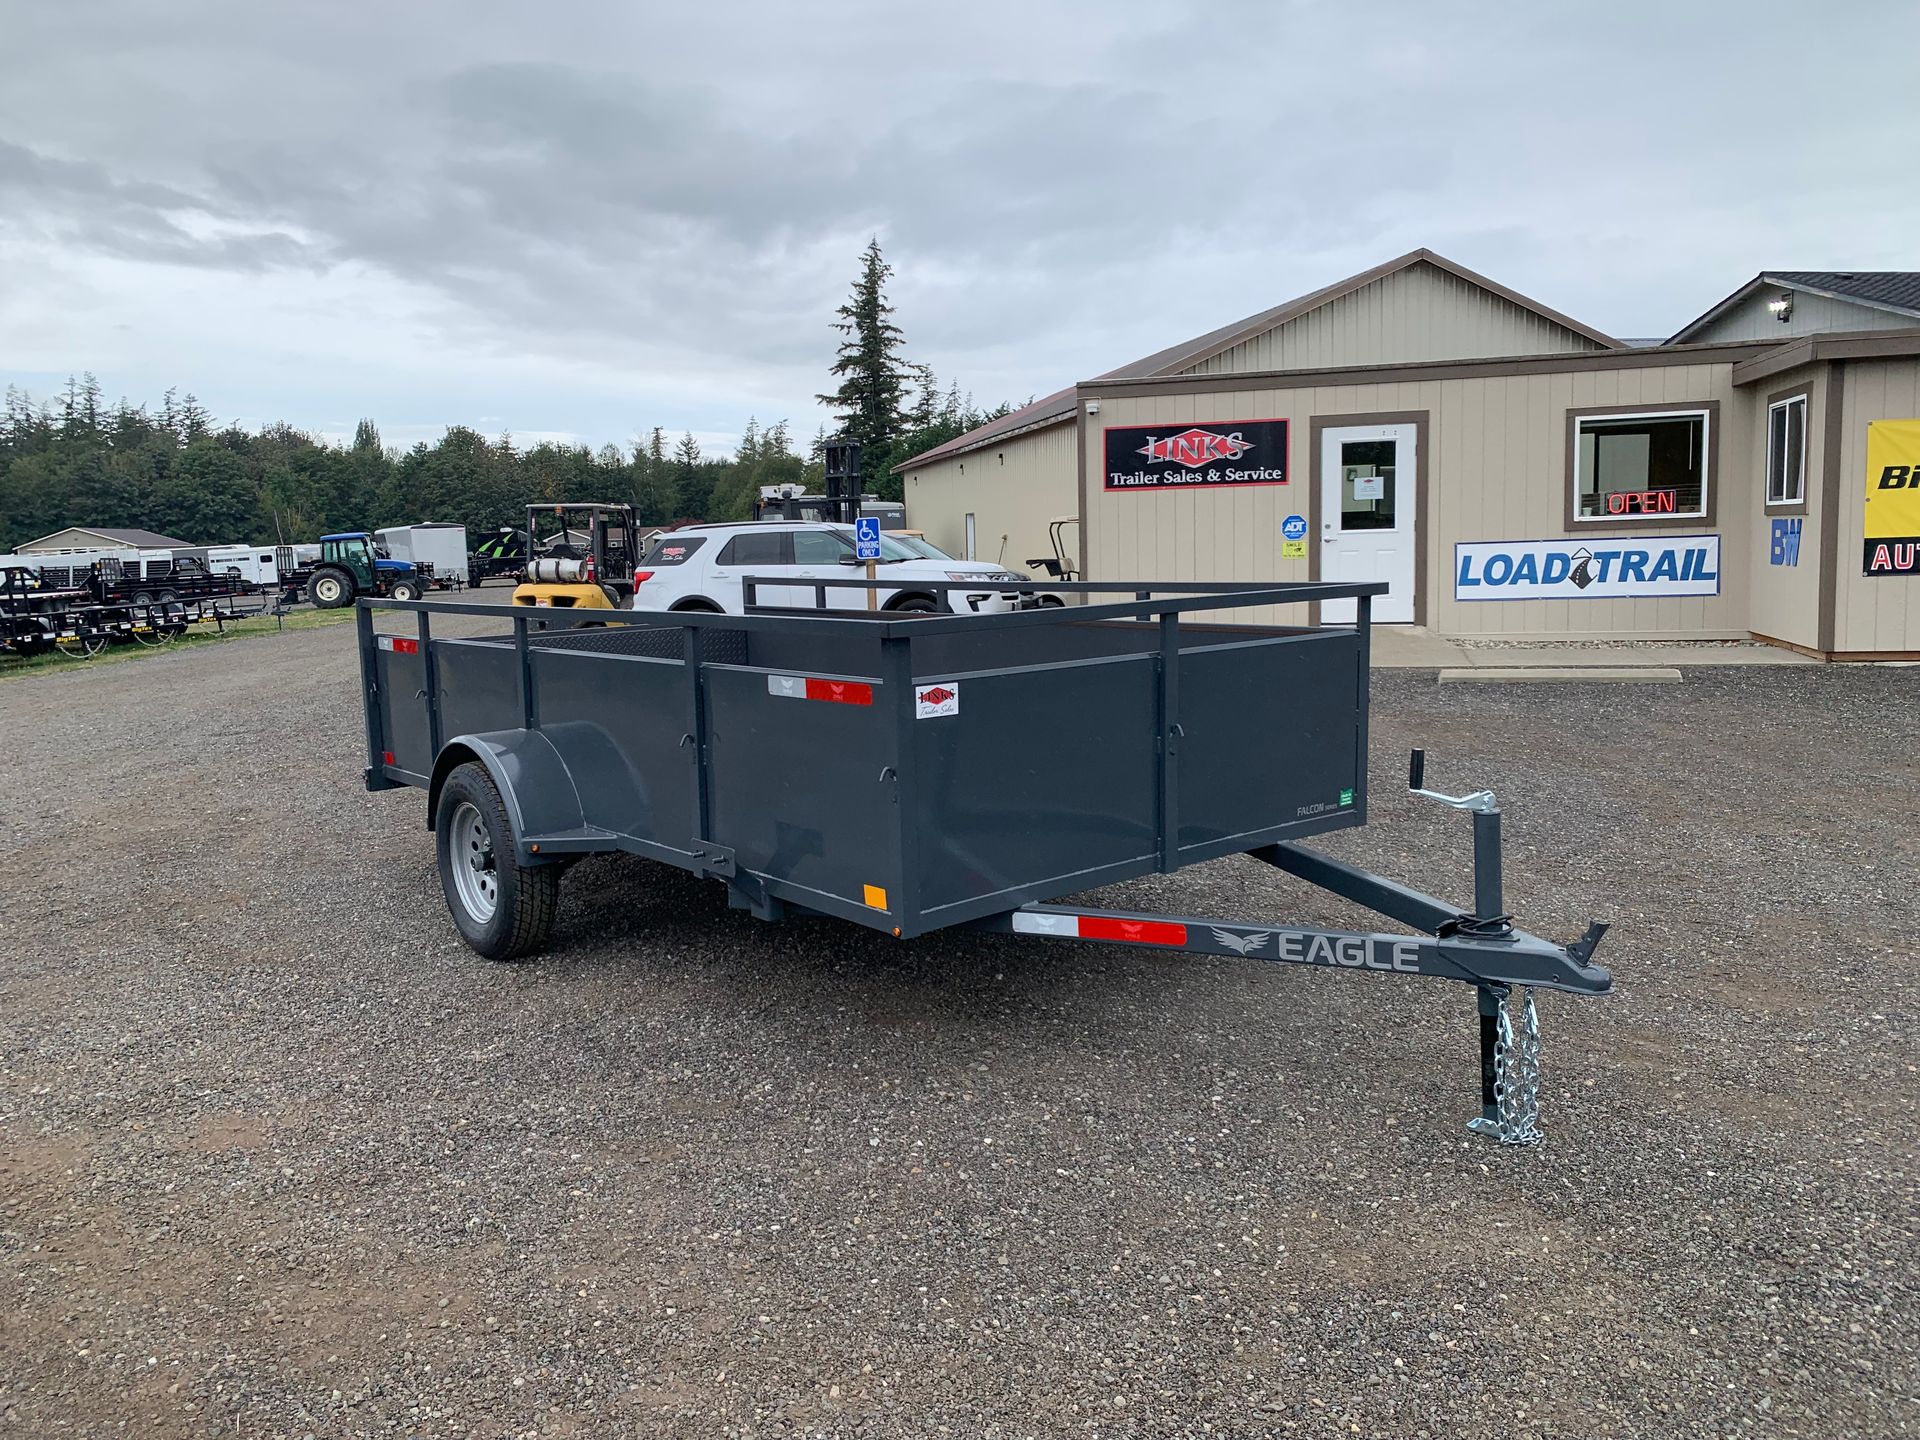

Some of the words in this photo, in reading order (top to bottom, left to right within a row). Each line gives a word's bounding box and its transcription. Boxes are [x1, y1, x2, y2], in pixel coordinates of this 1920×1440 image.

[1146, 431, 1245, 465] LINKS
[1110, 471, 1160, 486] Trailer
[1163, 469, 1203, 484] Sales
[1206, 468, 1221, 482] &
[1225, 466, 1282, 481] Service
[1608, 492, 1673, 513] OPEN
[1284, 521, 1305, 532] ADT
[858, 540, 879, 549] PARKING
[861, 548, 876, 557] ONLY
[1871, 543, 1920, 570] AU
[1458, 552, 1571, 586] LOAD
[1593, 548, 1717, 583] TRAIL
[920, 688, 955, 704] LINKS
[1297, 802, 1325, 816] FALCON
[1278, 932, 1420, 972] EAGLE
